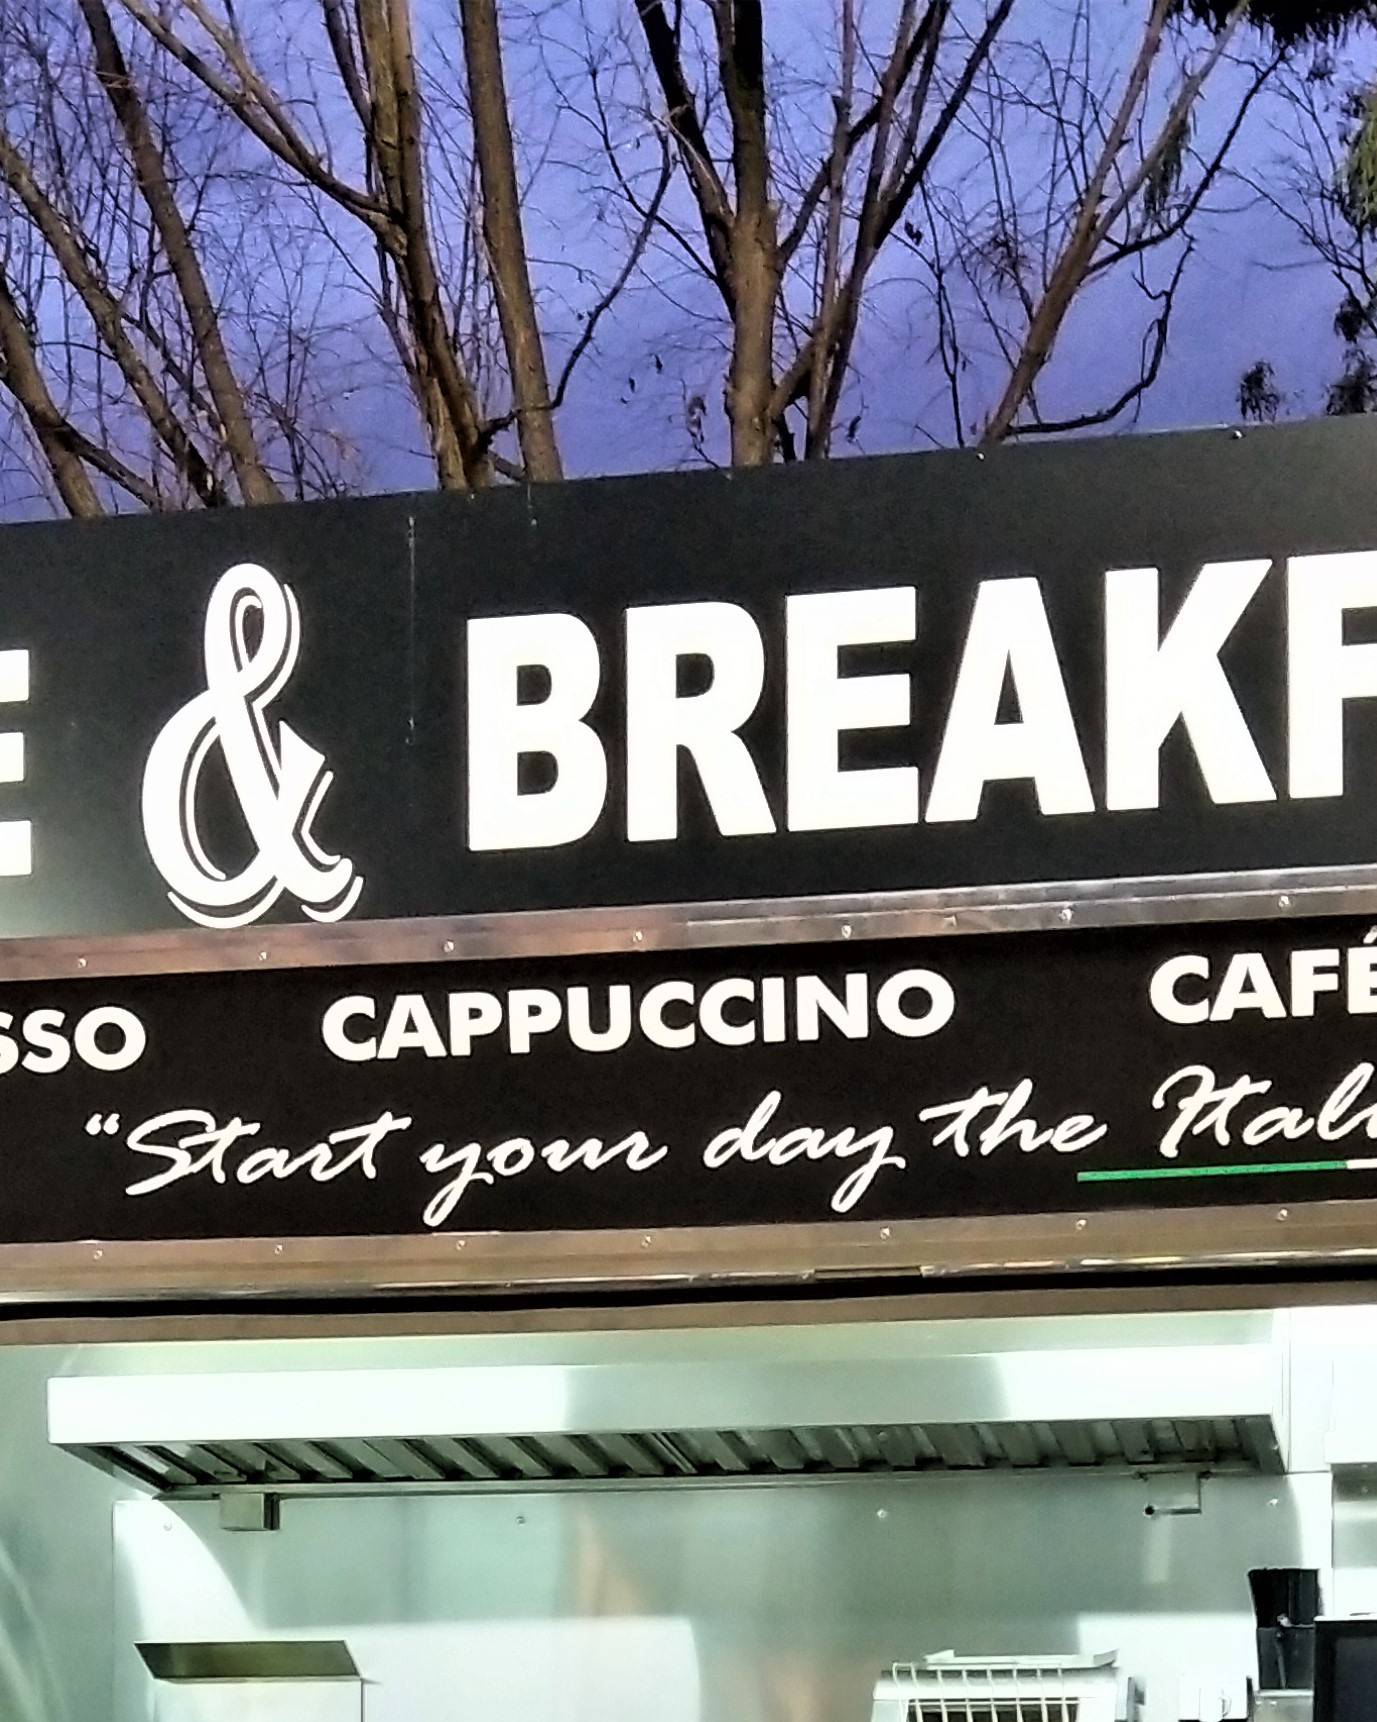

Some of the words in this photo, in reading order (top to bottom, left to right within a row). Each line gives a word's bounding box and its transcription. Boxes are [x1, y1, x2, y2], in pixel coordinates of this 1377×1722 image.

[141, 563, 364, 930] &
[321, 969, 956, 1062] CAPPUCCINO
[420, 1130, 668, 1226] your
[703, 1090, 906, 1213] day
[918, 1078, 1108, 1157] the
